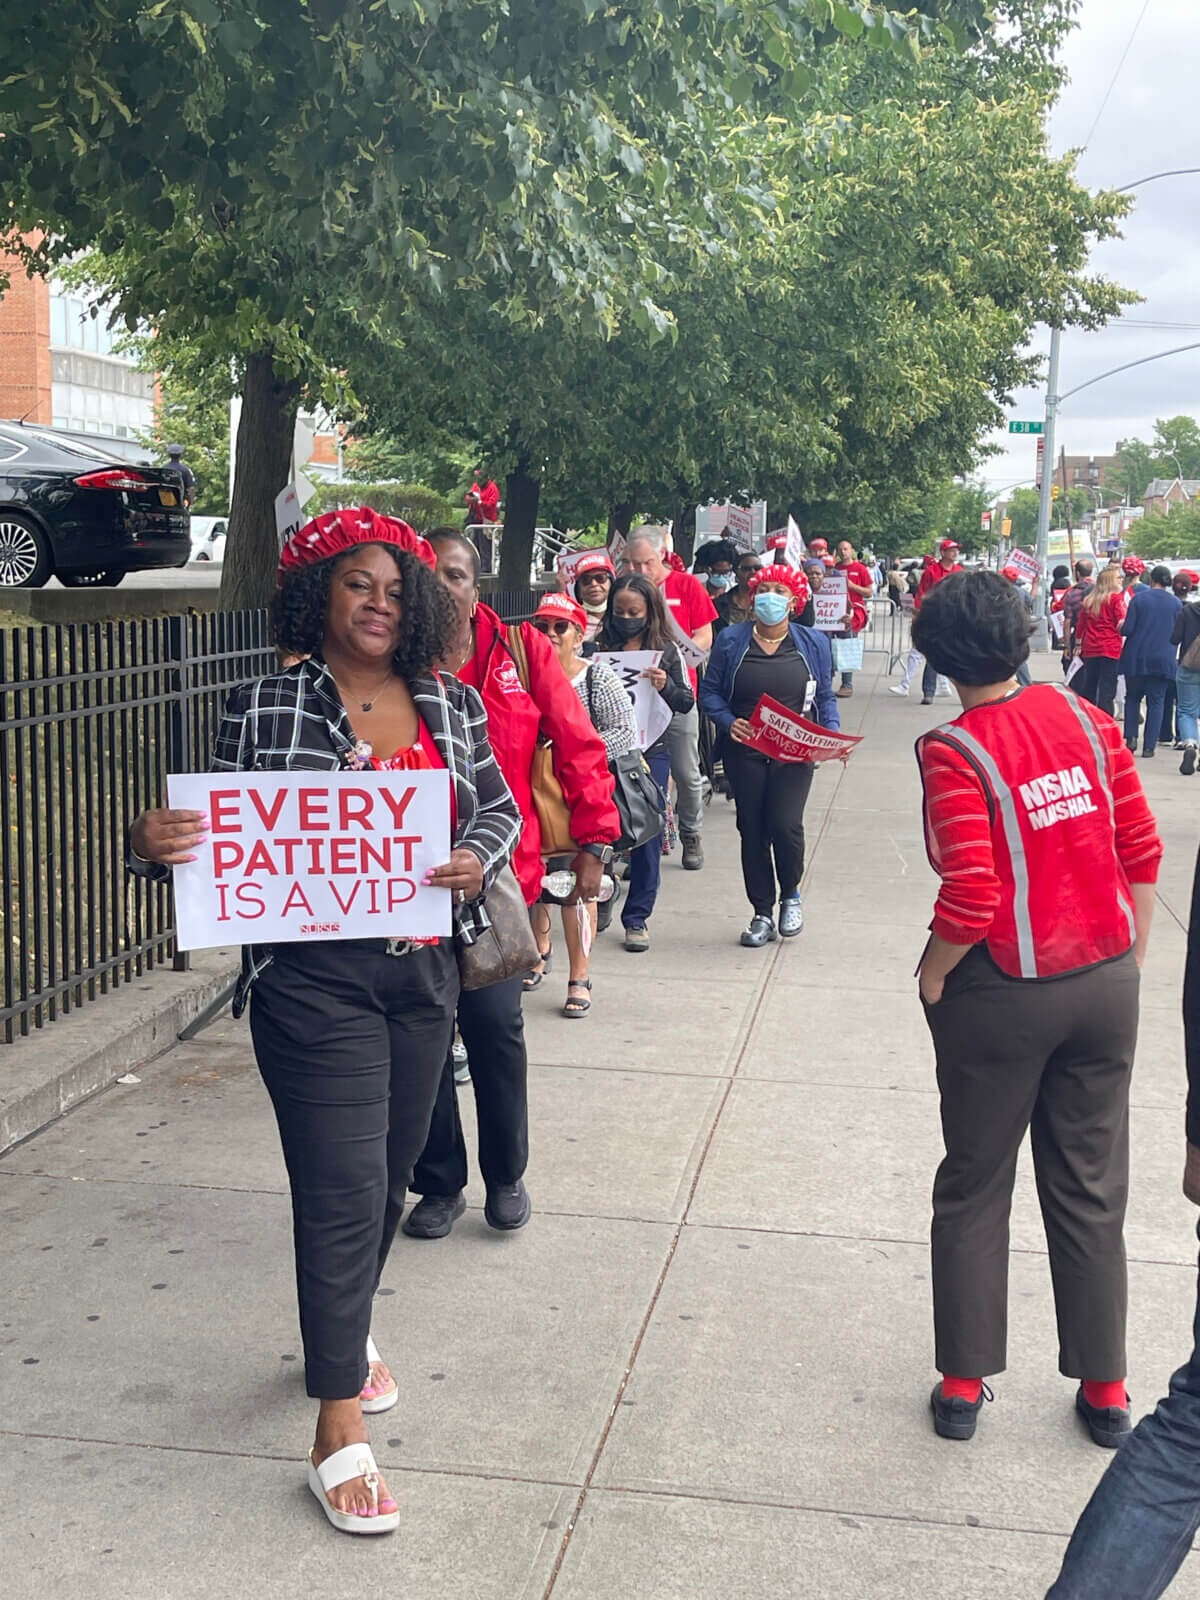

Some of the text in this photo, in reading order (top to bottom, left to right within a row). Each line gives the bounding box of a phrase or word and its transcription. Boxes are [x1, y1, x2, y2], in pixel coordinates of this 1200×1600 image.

[816, 599, 839, 608] Care
[768, 713, 793, 734] SAFE
[766, 729, 800, 755] SAVES
[209, 786, 417, 833] EVERY
[212, 836, 423, 878] PATIENT
[215, 878, 417, 921] IS A VIP
